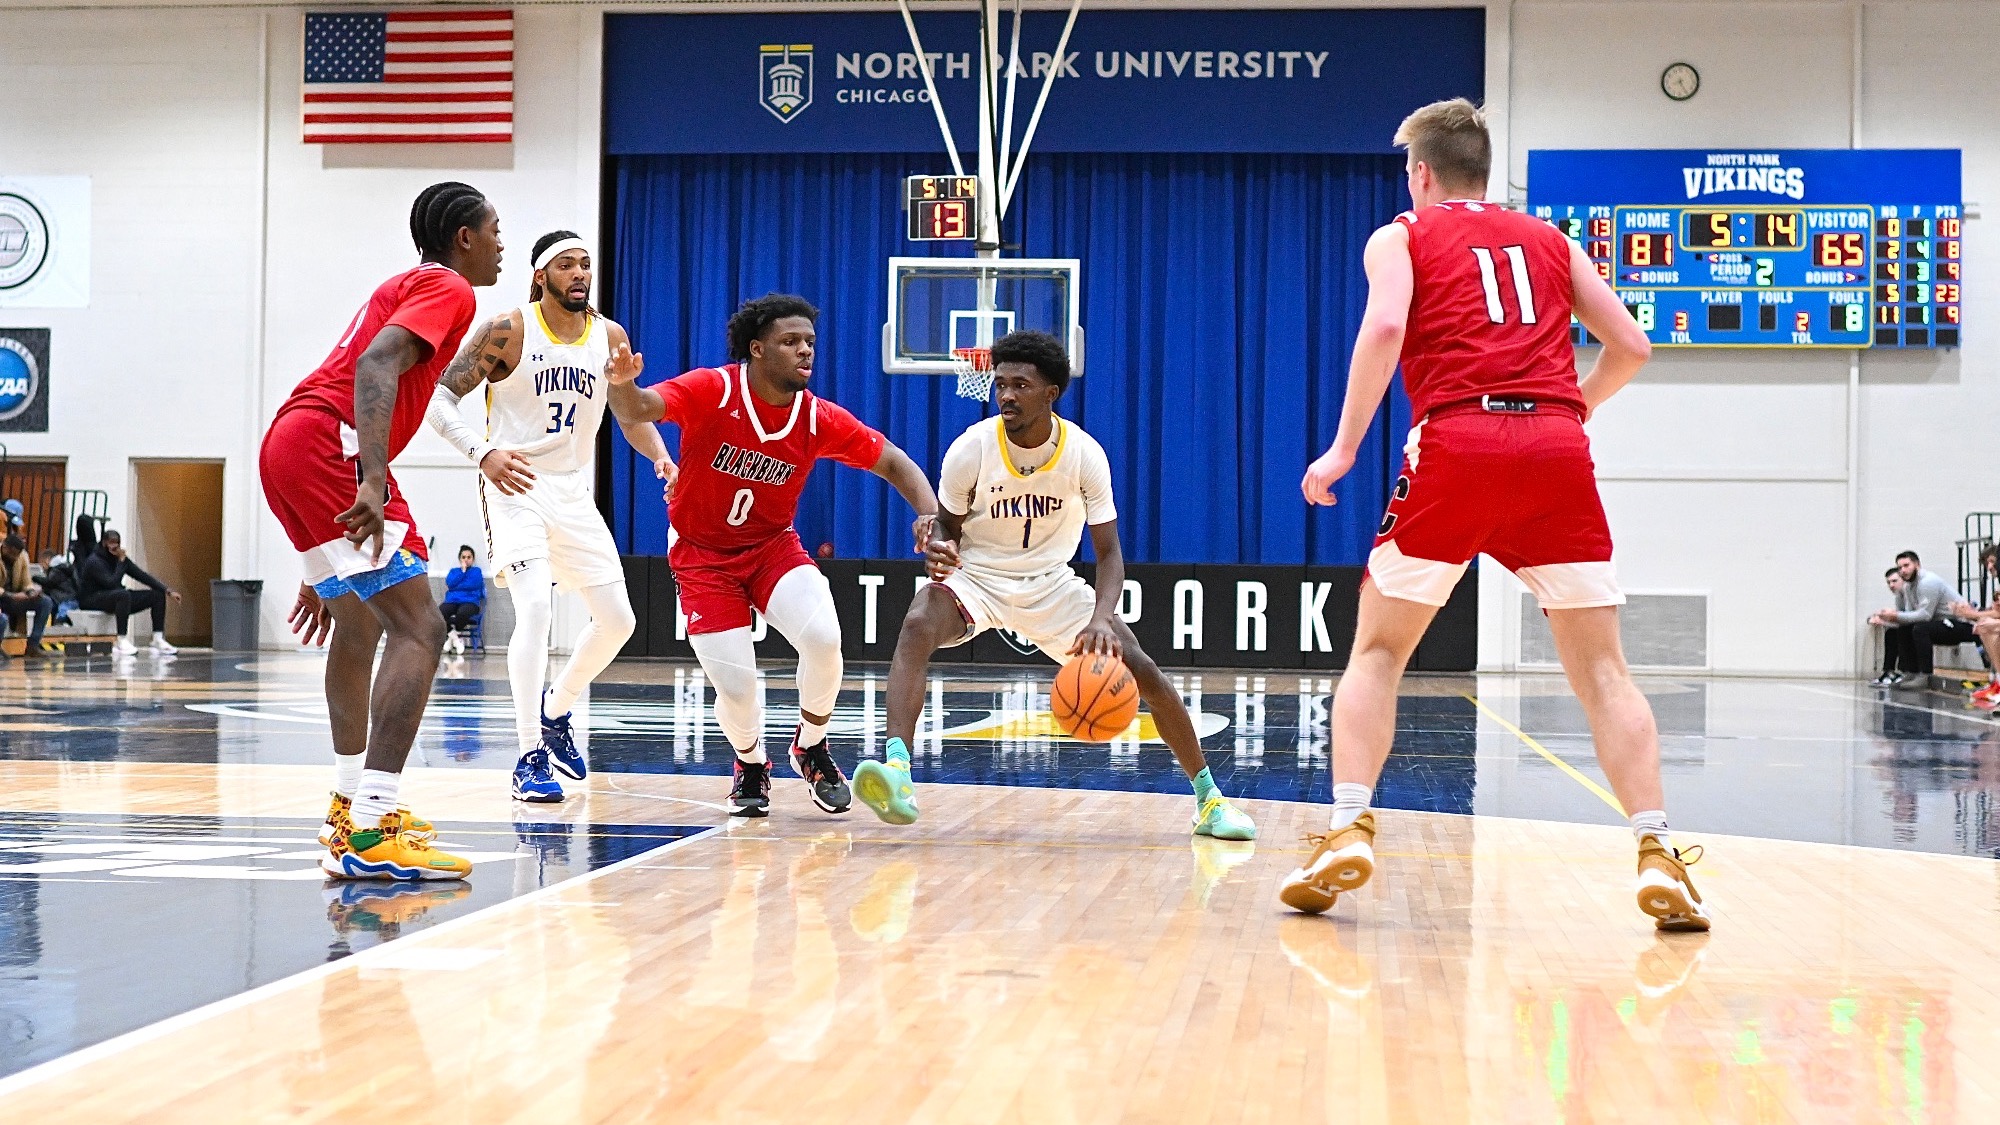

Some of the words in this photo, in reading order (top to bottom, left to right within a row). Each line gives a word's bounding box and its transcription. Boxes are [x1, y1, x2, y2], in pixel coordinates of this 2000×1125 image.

[836, 52, 970, 79] NORTH
[1095, 51, 1329, 78] UNIVERSITY
[836, 89, 931, 103] CHICAGO
[1707, 154, 1746, 166] NORTH
[1750, 154, 1780, 166] PARK
[1682, 167, 1805, 200] VIKINGS
[934, 203, 964, 237] 13
[1536, 206, 1552, 218] NO
[1567, 206, 1575, 218] F
[1589, 206, 1610, 218] PTS
[1625, 212, 1671, 228] HOME
[1807, 212, 1869, 229] VISITOR
[1881, 206, 1898, 218] NO
[1912, 206, 1921, 218] F
[1935, 206, 1958, 218] PTS
[1569, 218, 1582, 238] 2
[1593, 219, 1611, 237] 13
[1887, 218, 1900, 238] 0
[1923, 218, 1930, 238] 1
[1942, 218, 1960, 237] 10
[1593, 240, 1611, 258] 17
[1631, 233, 1673, 266] 81
[1822, 233, 1864, 267] 65
[1887, 240, 1900, 259] 2
[1916, 240, 1930, 259] 4
[1947, 240, 1960, 259] 8
[1641, 271, 1679, 283] BONUS
[1710, 264, 1752, 276] PERIOD
[1755, 258, 1774, 286] 2
[1805, 271, 1844, 284] BONUS
[1887, 262, 1900, 281] 4
[1916, 262, 1930, 281] 3
[1947, 262, 1960, 281] 9
[1470, 244, 1537, 324] 11
[1887, 283, 1899, 303] 5
[1916, 283, 1930, 303] 3
[1935, 284, 1960, 303] 23
[1621, 291, 1655, 303] FOULS
[1701, 291, 1743, 304] PLAYER
[1758, 291, 1794, 304] FOULS
[1828, 291, 1864, 304] FOULS
[1637, 303, 1656, 331] 8
[1675, 311, 1688, 331] 3
[1796, 311, 1809, 331] 2
[1845, 303, 1864, 332] 8
[1880, 305, 1900, 325] 11
[1922, 305, 1930, 325] 1
[1947, 305, 1959, 324] 9
[1670, 331, 1692, 343] TOL
[1791, 331, 1813, 343] TOL
[534, 366, 596, 400] VIKINGS
[545, 402, 577, 434] 34
[710, 442, 797, 486] BLACKBURN
[726, 488, 755, 527] 0
[1021, 518, 1032, 549] 1
[1113, 579, 1333, 652] PARK
